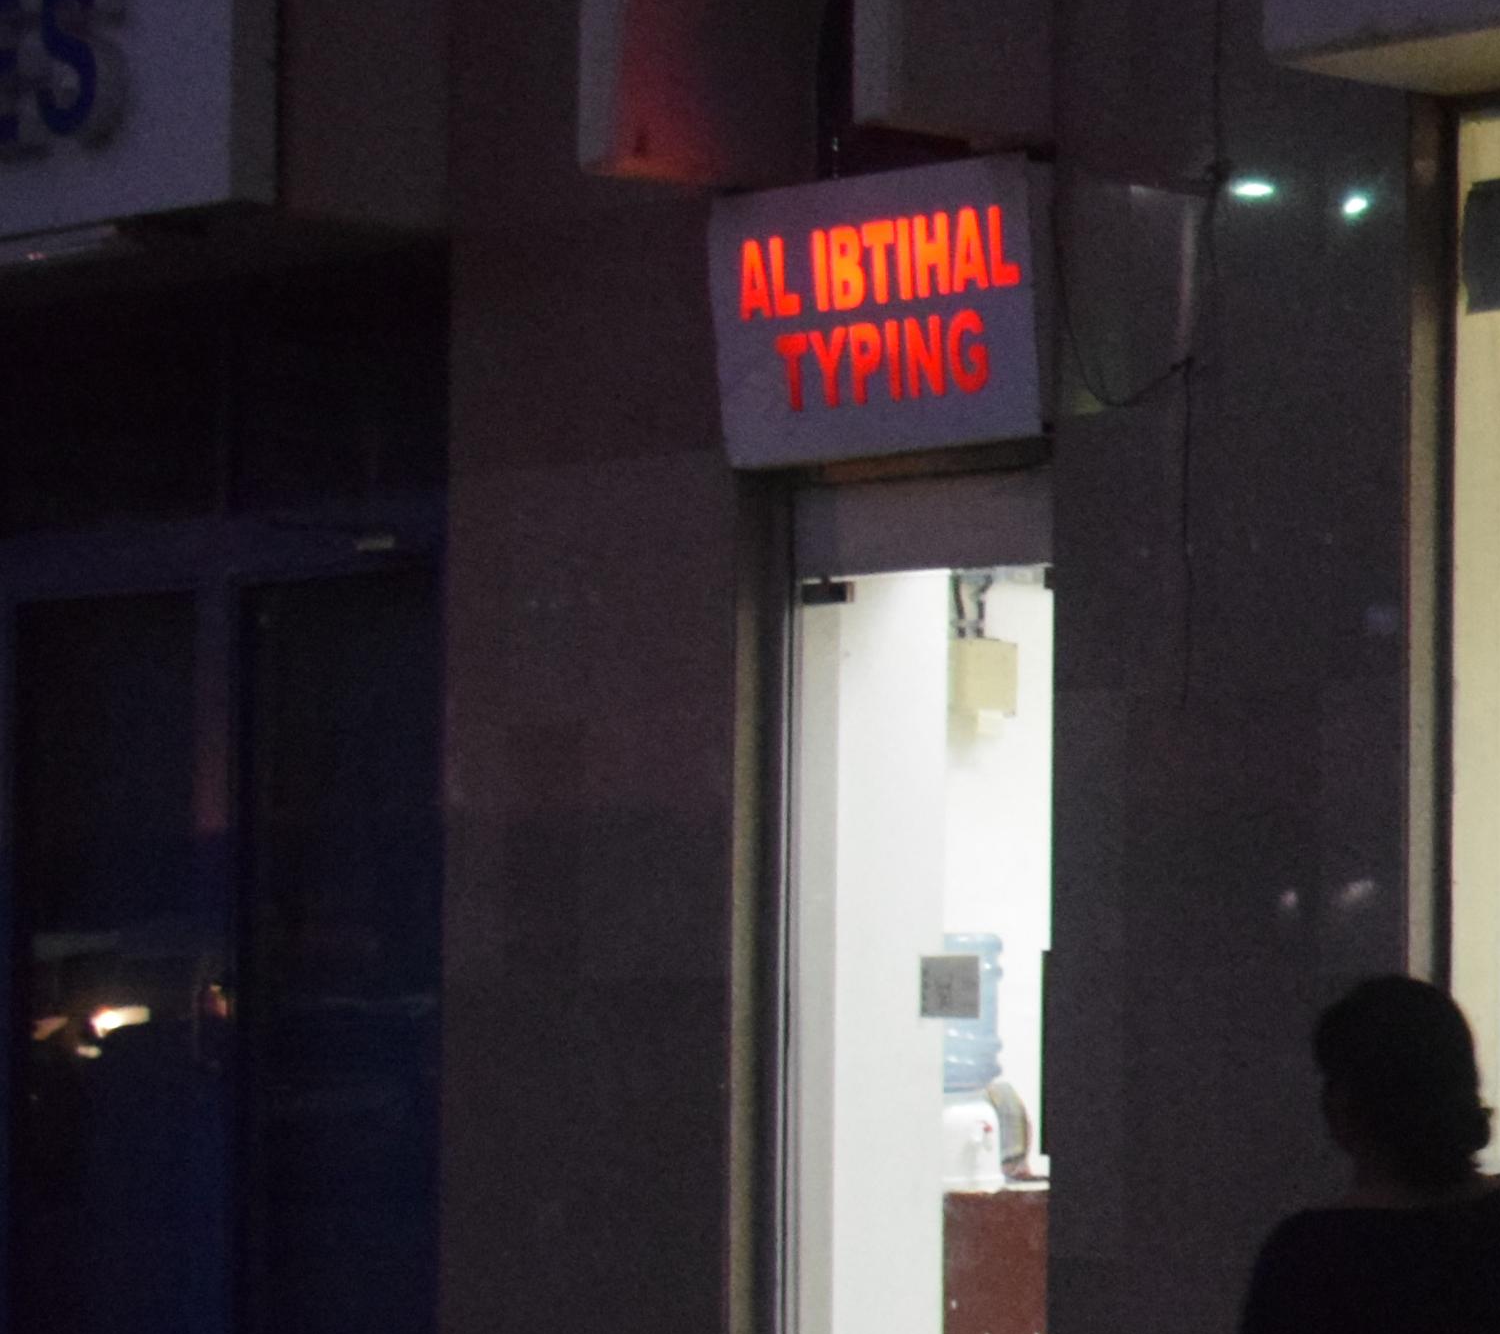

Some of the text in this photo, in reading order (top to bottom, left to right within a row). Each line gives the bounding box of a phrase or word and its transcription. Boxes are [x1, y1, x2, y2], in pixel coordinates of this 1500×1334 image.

[739, 204, 1022, 322] AL IBTIHAL
[774, 308, 989, 412] TYPING
